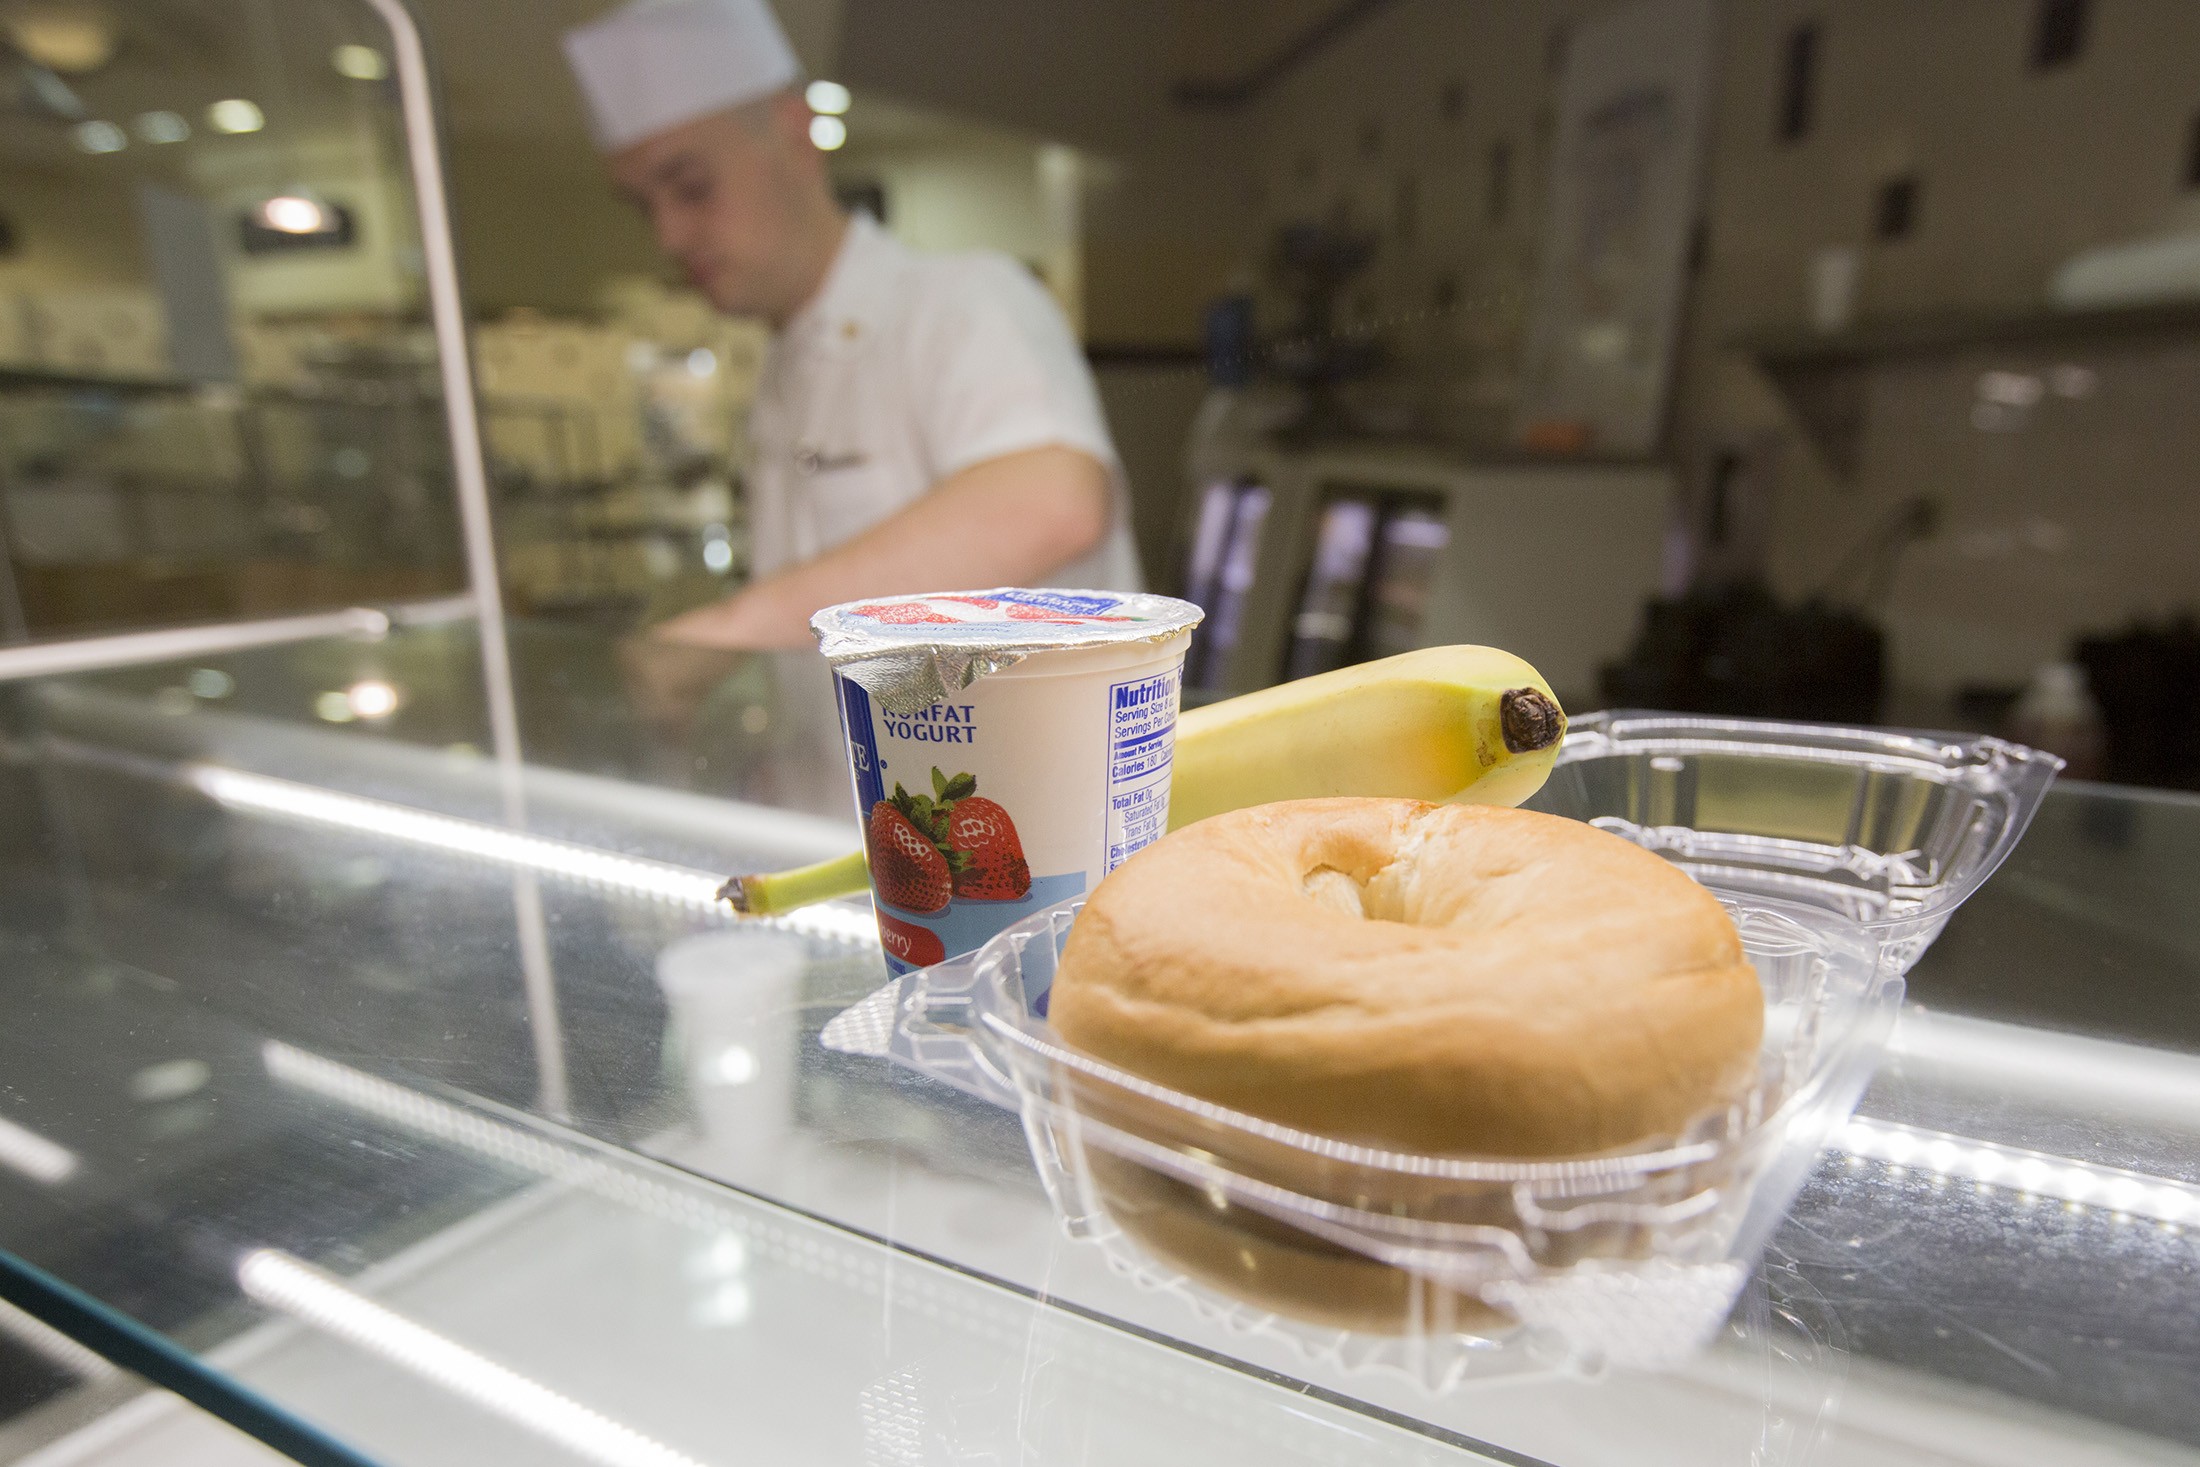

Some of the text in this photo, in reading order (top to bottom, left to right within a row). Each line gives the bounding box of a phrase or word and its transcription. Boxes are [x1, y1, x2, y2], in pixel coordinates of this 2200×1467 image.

[1115, 677, 1176, 710] Nutrition
[882, 704, 975, 723] NFAT
[1115, 707, 1149, 723] Serving
[1150, 701, 1164, 715] Size
[883, 719, 977, 744] YOGURT
[1114, 721, 1152, 739] Servings
[1153, 715, 1164, 729] Per
[1113, 747, 1137, 761] Amount
[1138, 745, 1148, 755] Per
[1112, 761, 1145, 778] Calories
[1112, 794, 1132, 811] Total
[1133, 790, 1145, 805] Fat
[1124, 803, 1153, 823] Saturated
[1124, 825, 1142, 839] Trans
[1143, 819, 1152, 832] Fat
